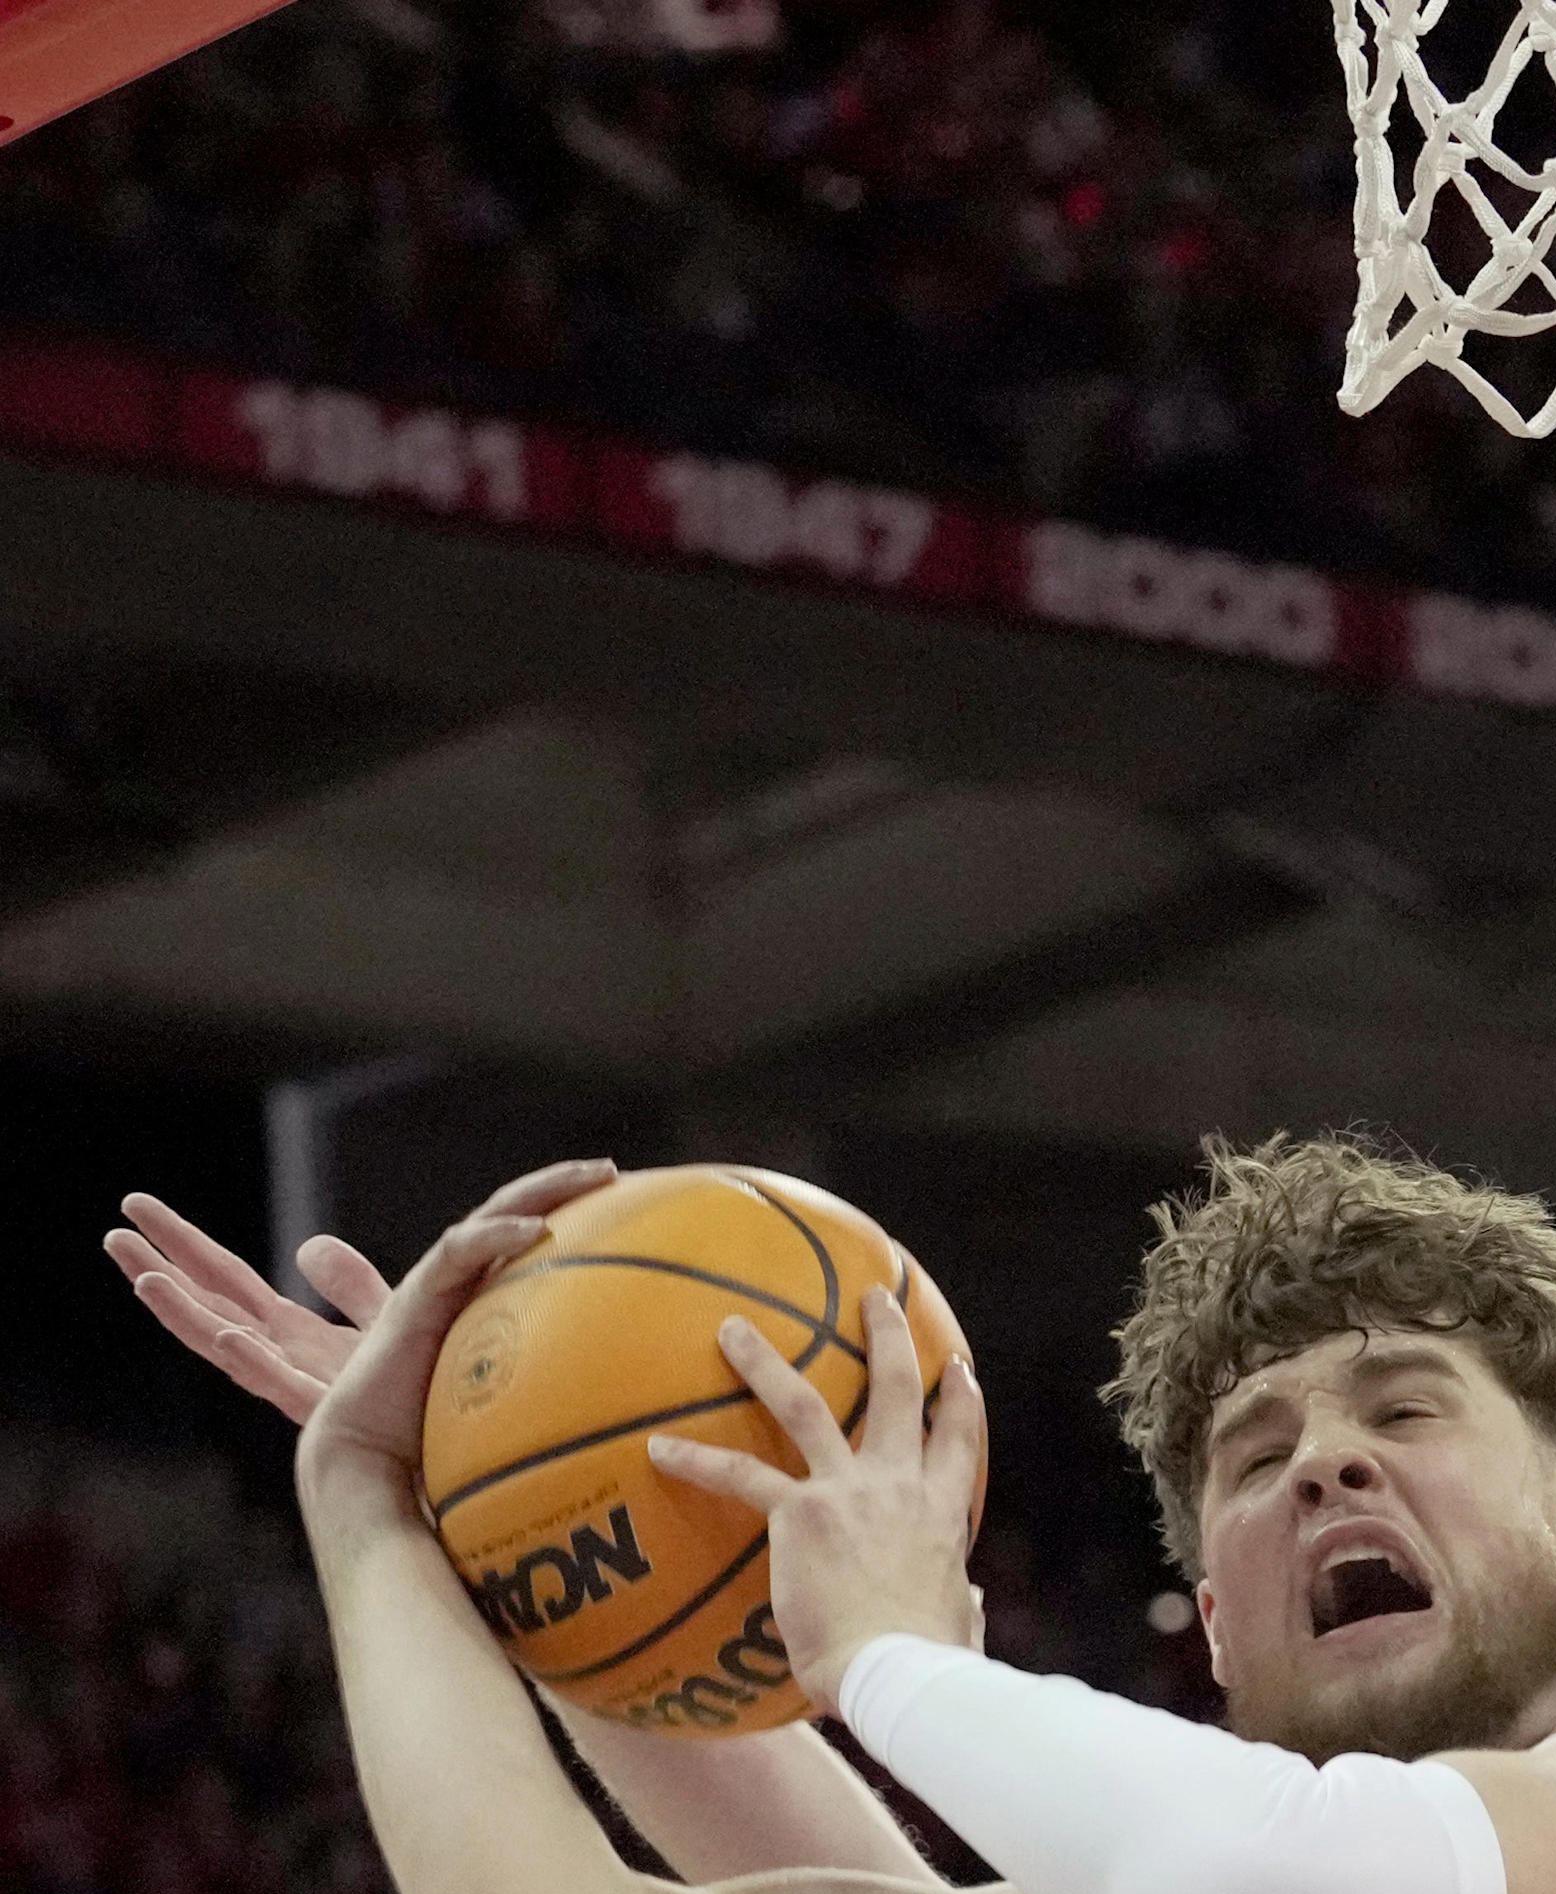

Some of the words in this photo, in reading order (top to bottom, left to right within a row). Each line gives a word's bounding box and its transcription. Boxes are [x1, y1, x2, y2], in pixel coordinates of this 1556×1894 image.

[240, 379, 530, 520] 1941
[650, 454, 934, 587] 1947
[1026, 517, 1336, 668] 2000
